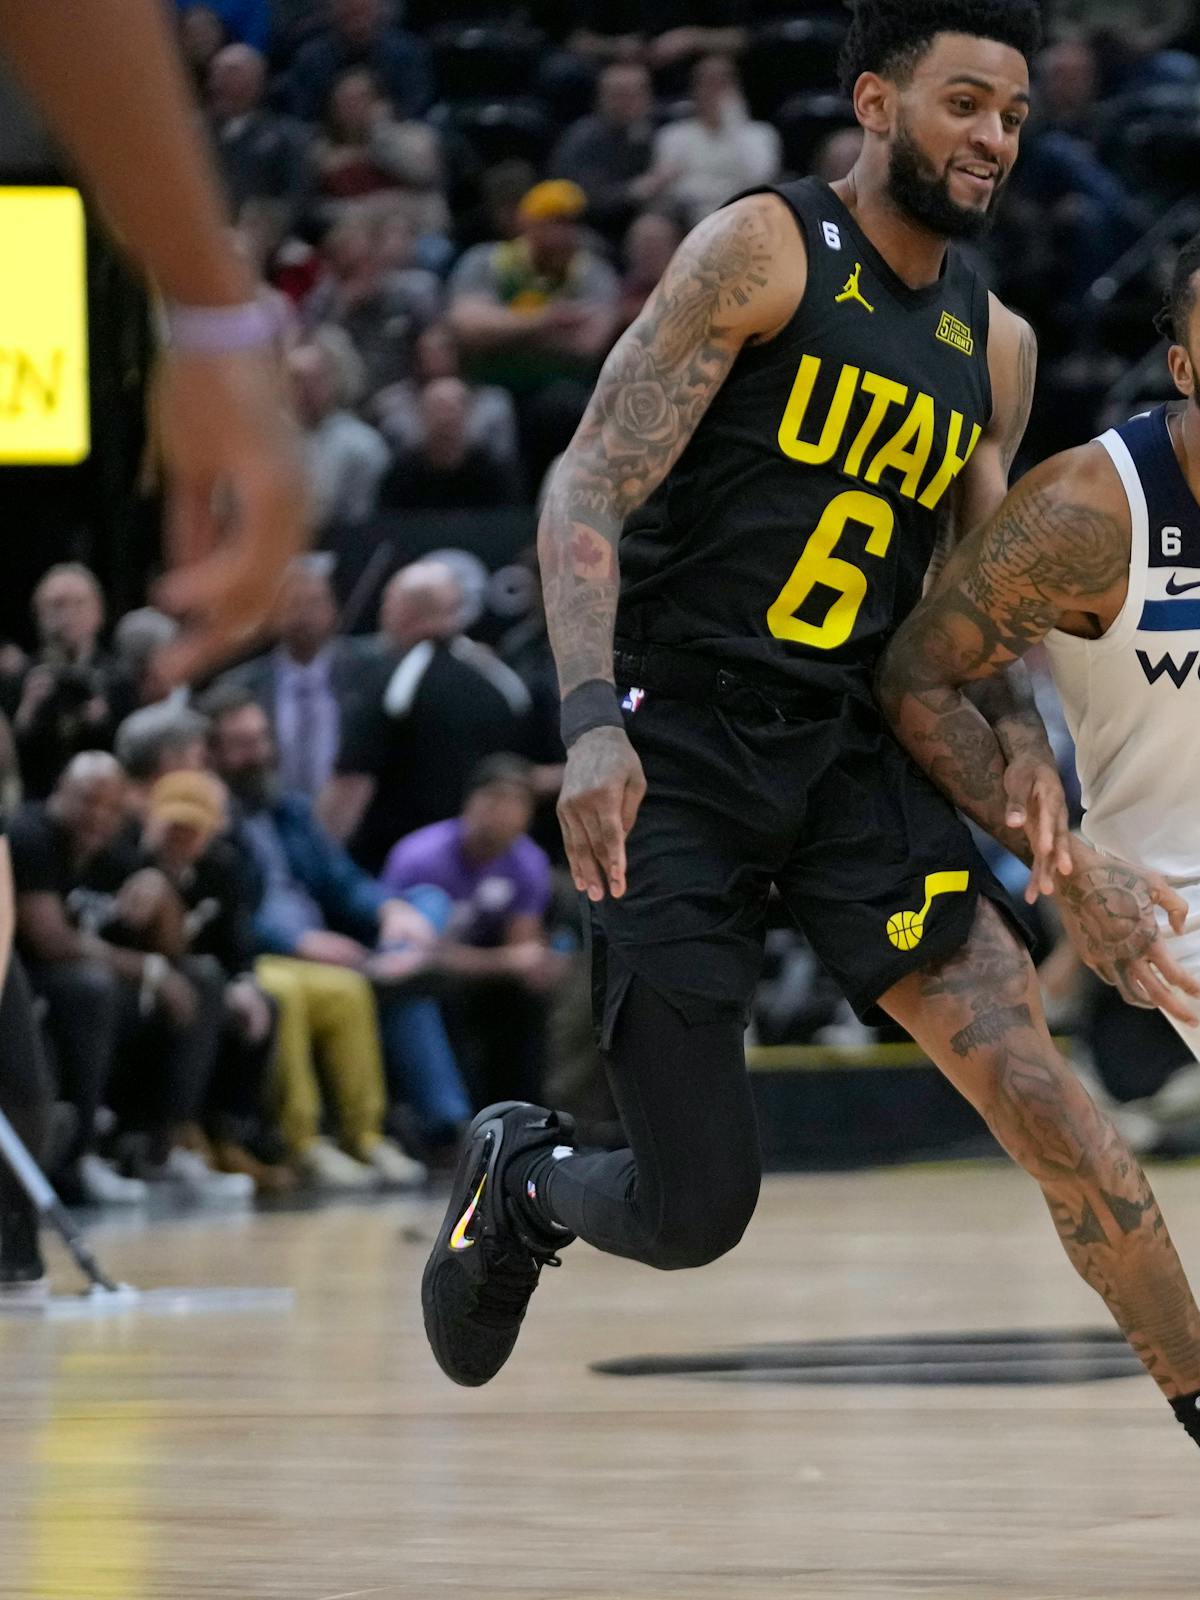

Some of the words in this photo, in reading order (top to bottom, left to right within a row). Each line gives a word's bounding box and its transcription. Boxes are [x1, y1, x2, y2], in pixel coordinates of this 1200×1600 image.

[822, 220, 841, 251] 6
[940, 315, 951, 337] 5
[777, 353, 982, 510] UTAH
[1161, 526, 1182, 557] 6
[766, 489, 894, 649] 6
